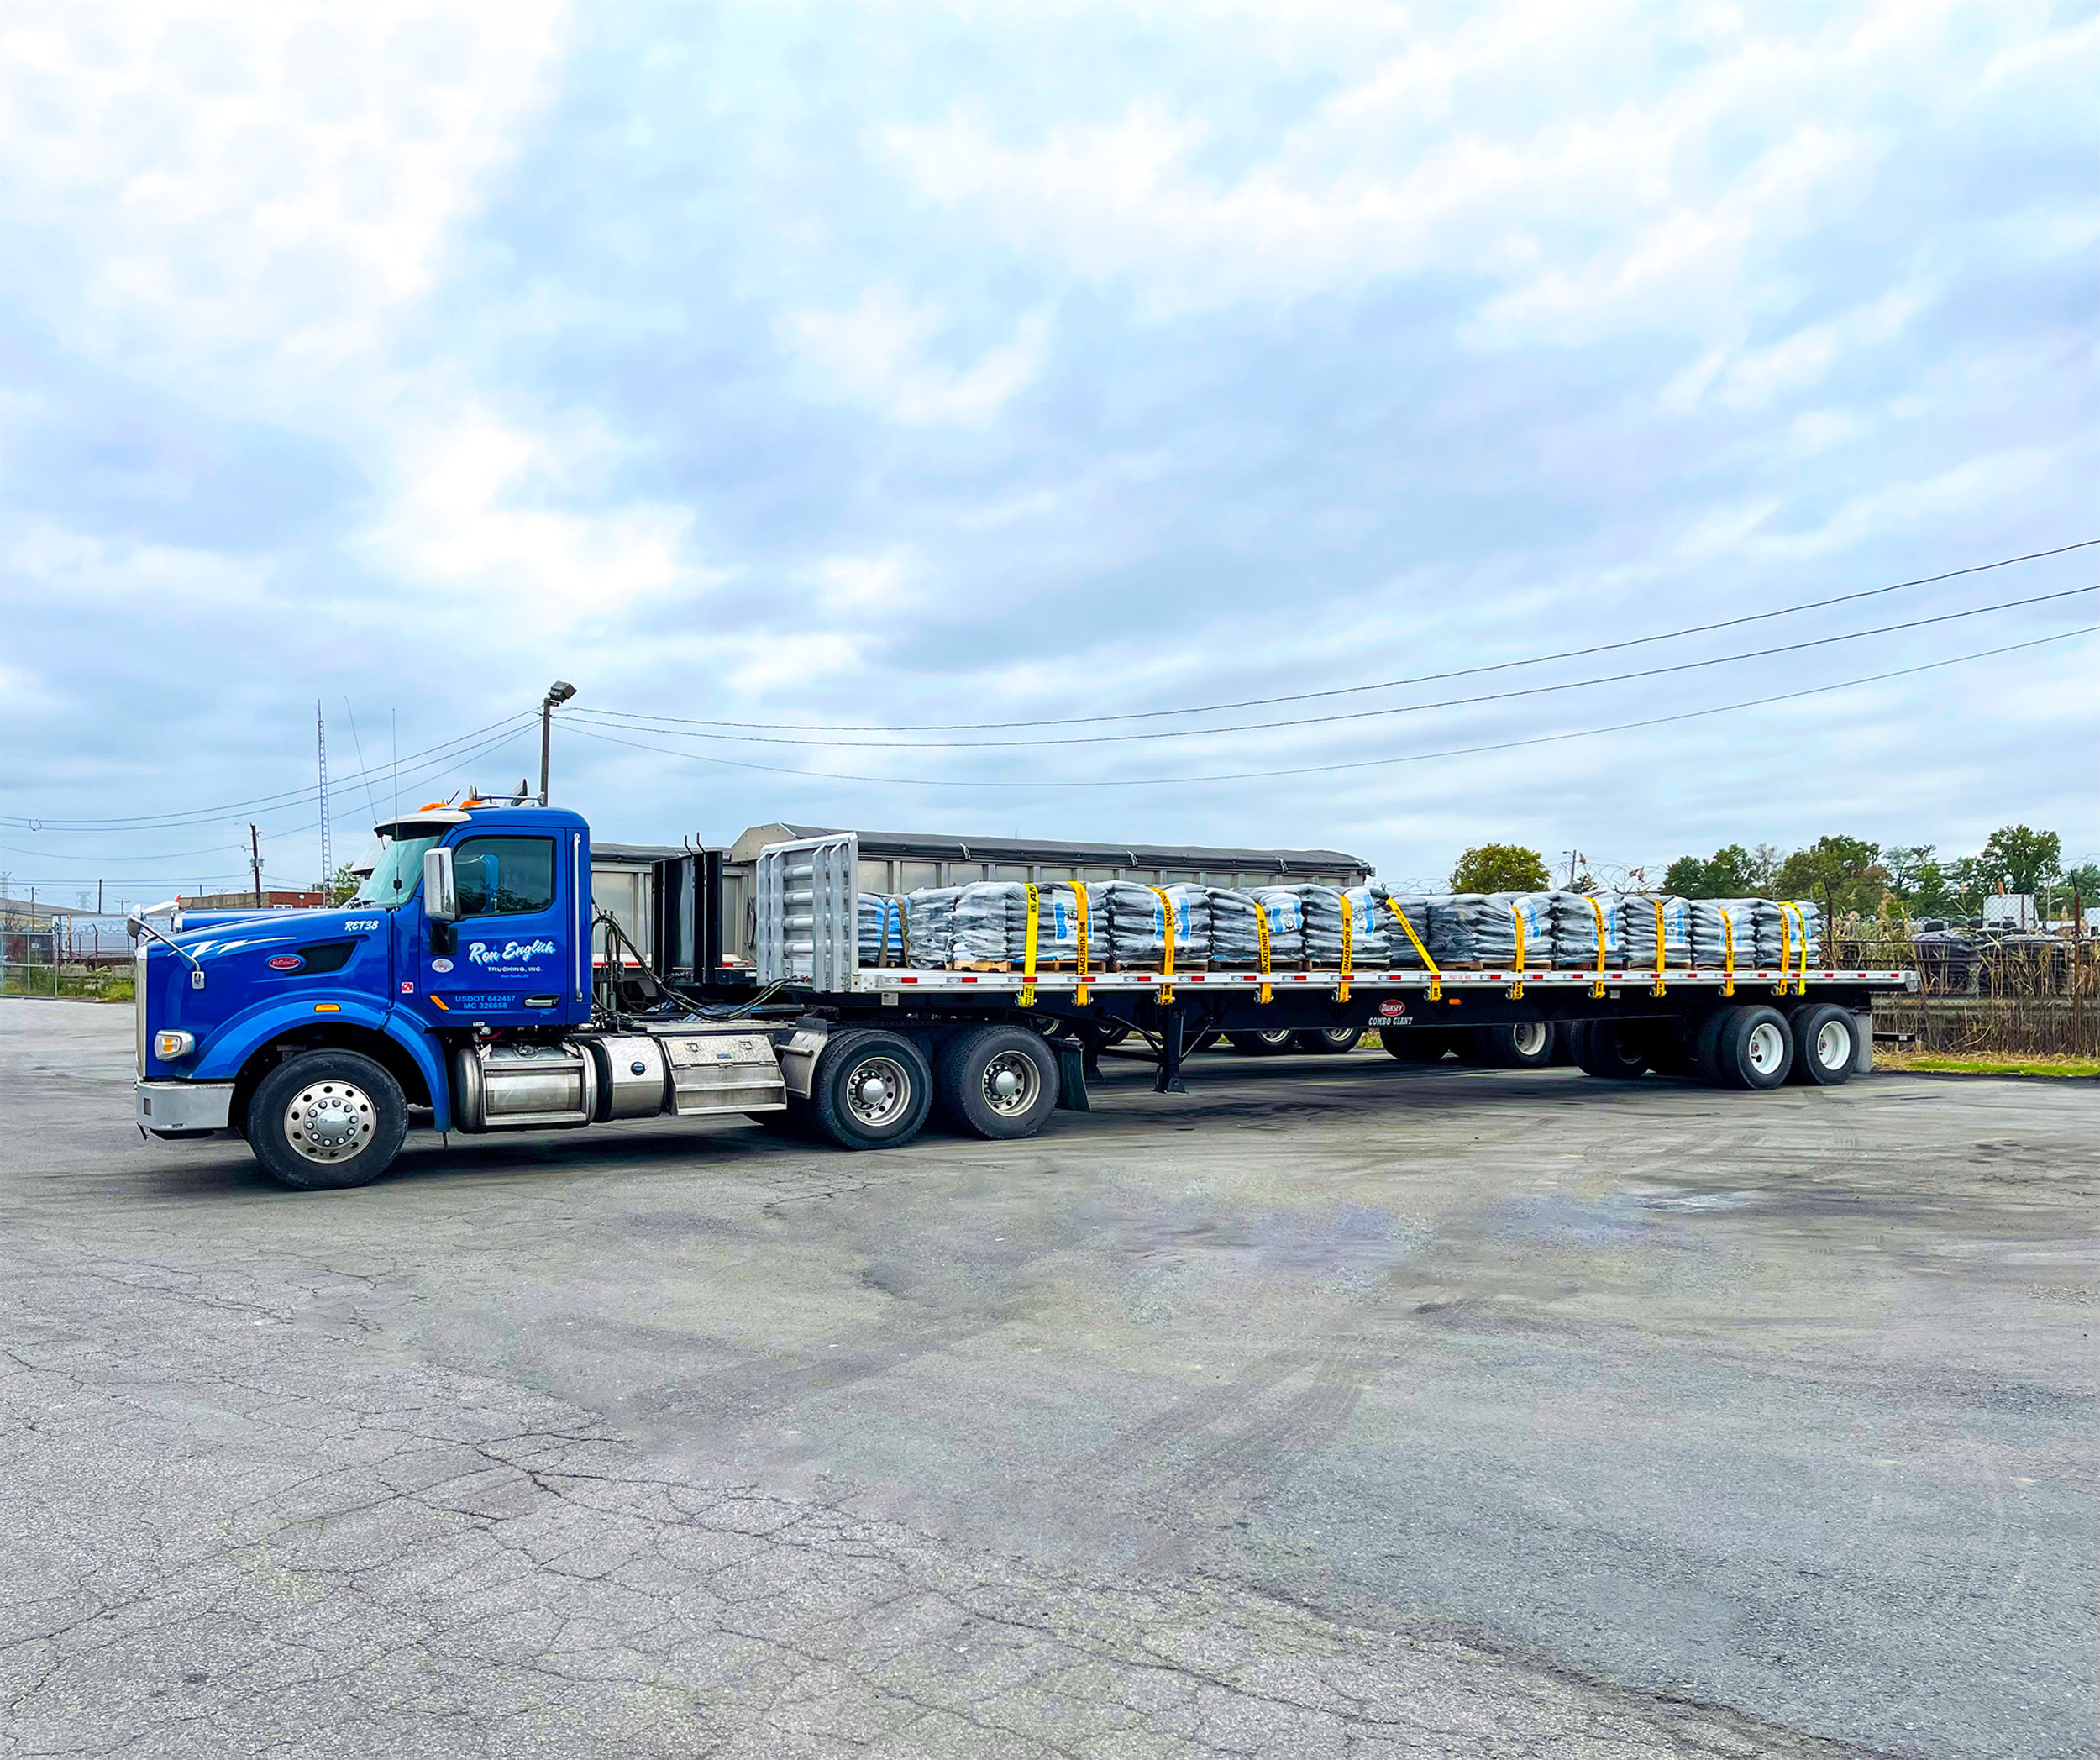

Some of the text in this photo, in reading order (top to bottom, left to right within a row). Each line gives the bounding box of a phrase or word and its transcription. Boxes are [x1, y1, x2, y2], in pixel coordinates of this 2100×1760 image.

[344, 920, 379, 931] RET38
[468, 938, 557, 966] Ron English
[1368, 1017, 1413, 1026] COMBO GIANT
